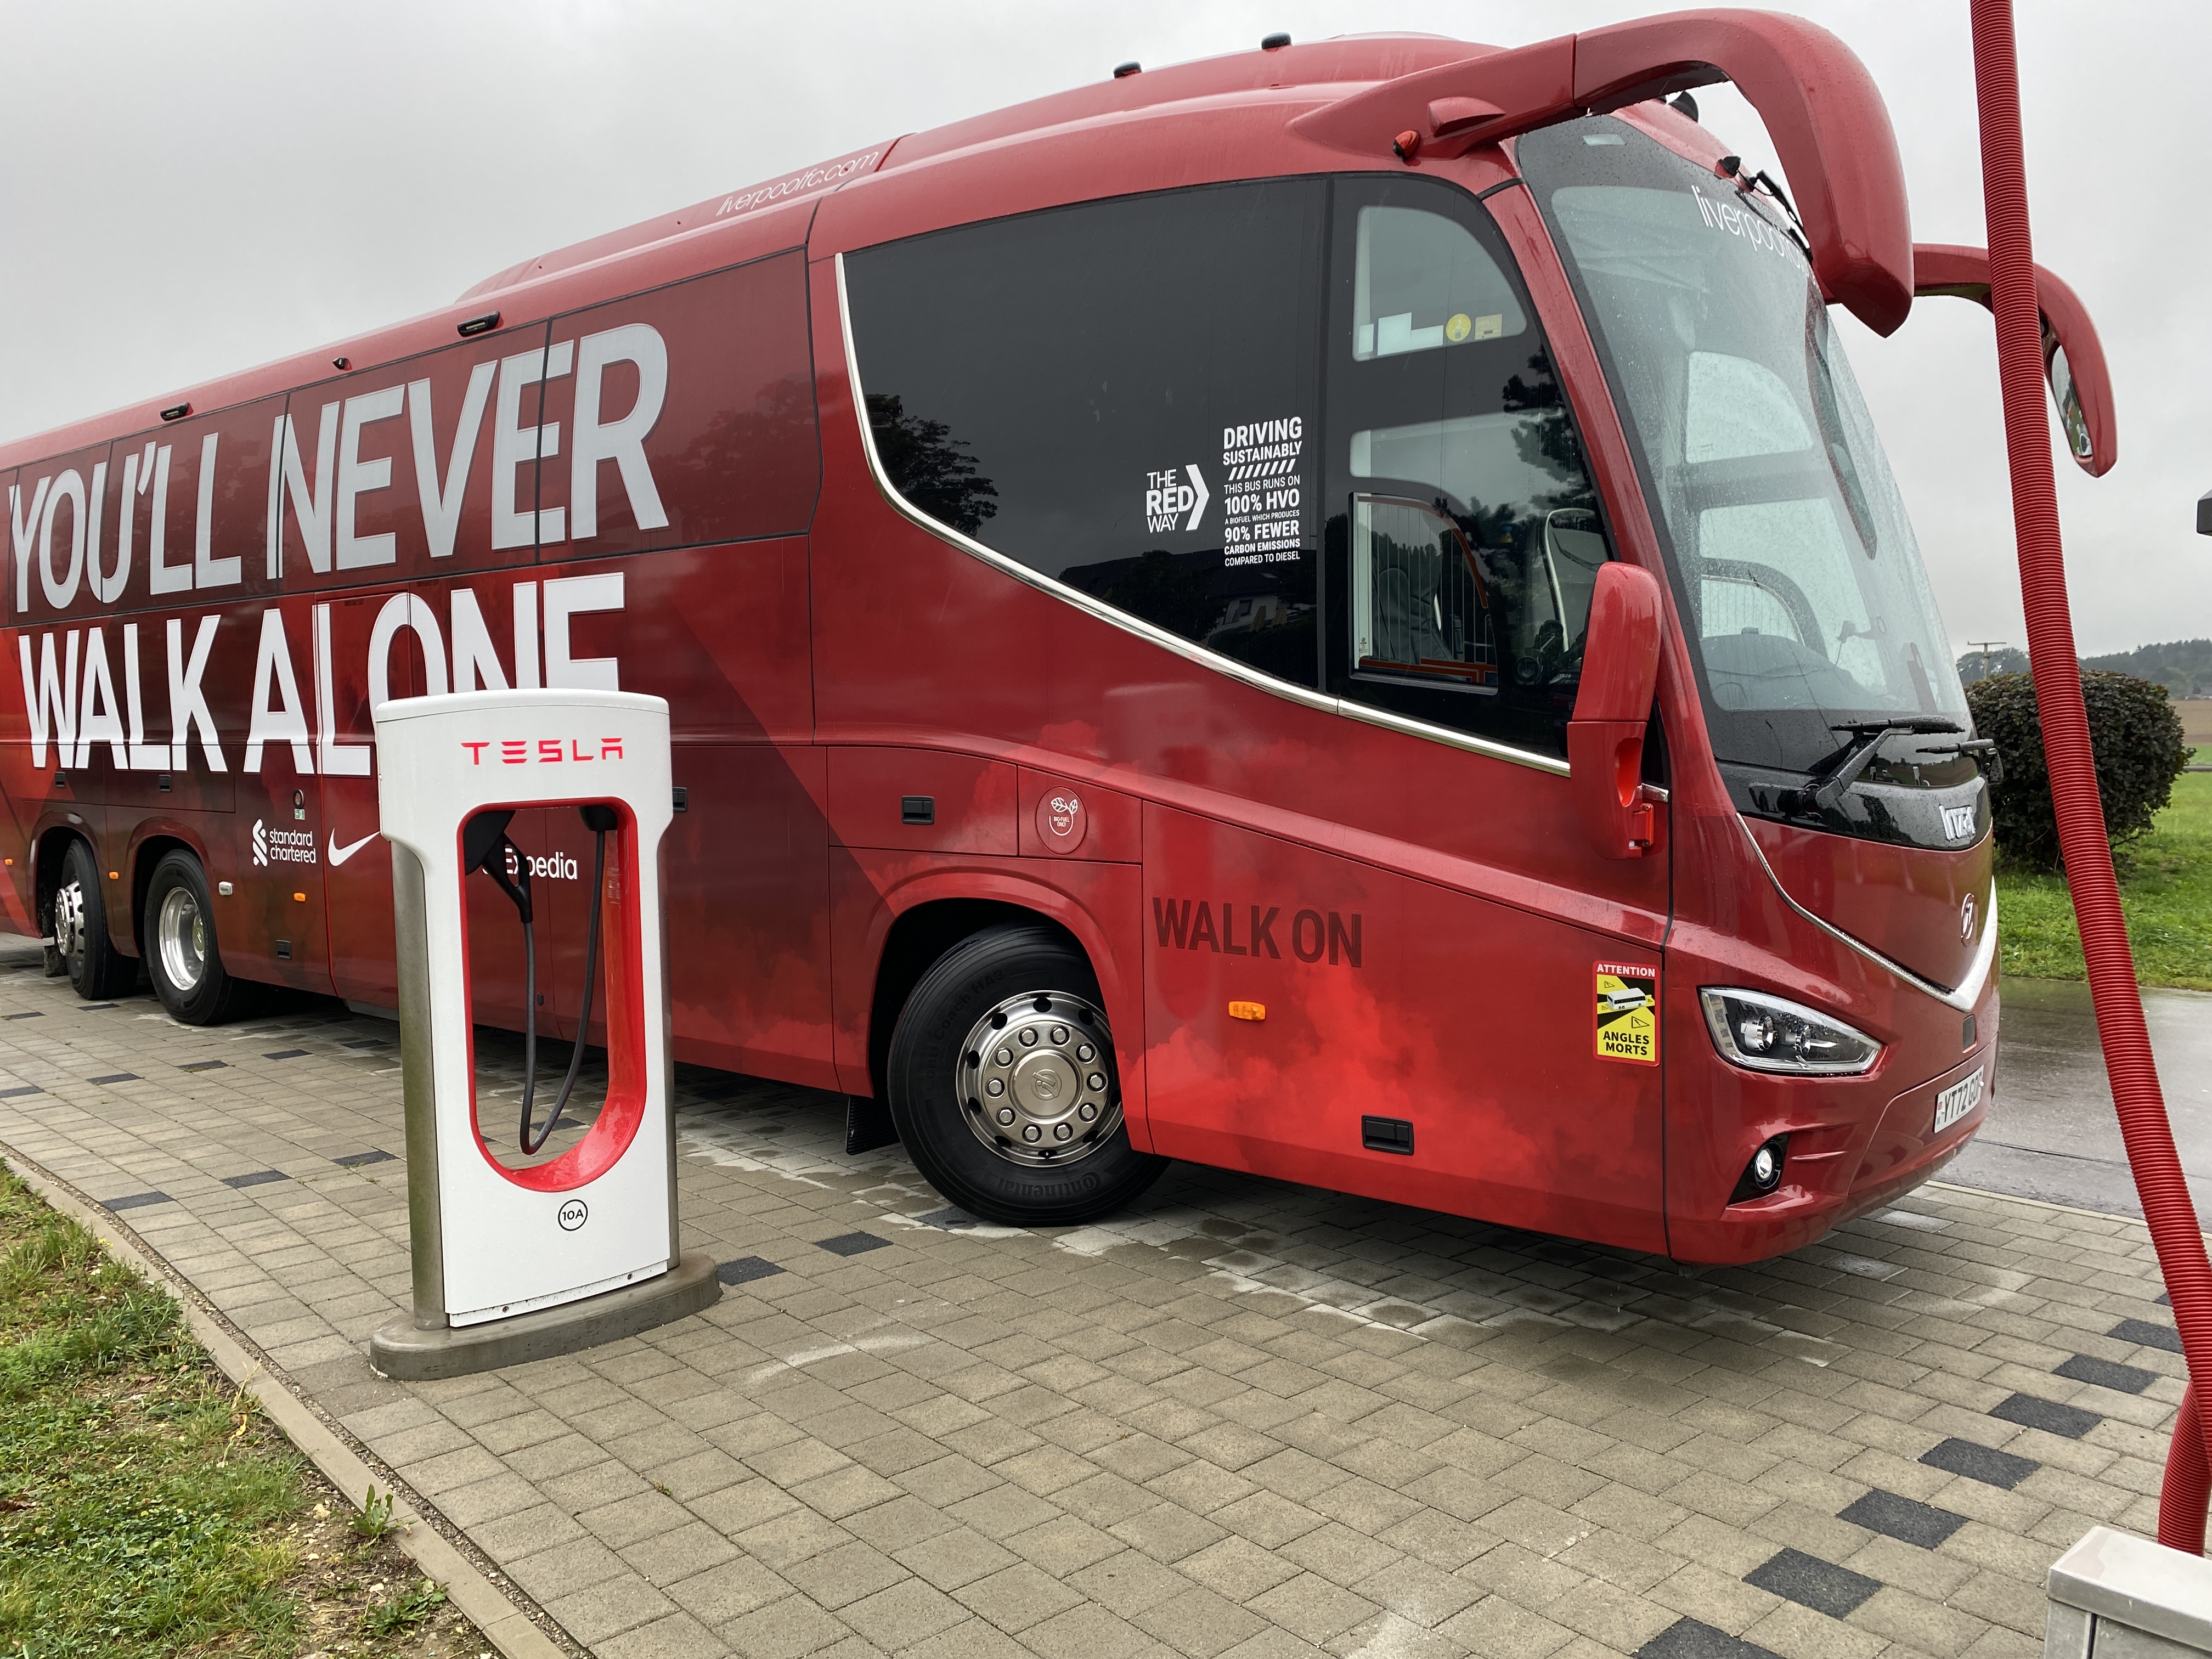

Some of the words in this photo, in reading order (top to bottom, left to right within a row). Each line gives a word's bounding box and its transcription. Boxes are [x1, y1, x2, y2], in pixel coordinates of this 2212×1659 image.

[716, 151, 879, 216] liverpoolfc.com
[1223, 416, 1302, 449] DRIVING
[1223, 441, 1302, 466] SUSTAINABLY
[8, 432, 242, 613] YOU'LL
[267, 323, 669, 580] NEVER
[1147, 469, 1177, 489] THE
[1223, 483, 1243, 495] THIS
[1244, 480, 1261, 492] BUS
[1263, 477, 1285, 489] RUNS
[1288, 475, 1300, 486] ON
[1146, 485, 1194, 516] RED
[1224, 493, 1262, 515] 100%
[1266, 488, 1300, 510] HVO
[1147, 513, 1179, 533] WAY
[1229, 515, 1251, 524] BIOFUEL
[1252, 514, 1270, 522] WHICH
[1271, 510, 1300, 520] PRODUCES
[1224, 525, 1250, 543] 90%
[1254, 520, 1300, 540] FEWER
[1224, 544, 1256, 555] CARBON
[1257, 538, 1301, 552] EMISSIONS
[1224, 555, 1263, 567] COMPARED
[1264, 554, 1274, 563] TO
[1276, 550, 1301, 561] DIESEL
[18, 614, 228, 772] WALK
[461, 737, 623, 765] TESLA
[269, 828, 313, 847] standard
[270, 847, 317, 864] chartered
[1153, 896, 1282, 960] WALK
[1291, 909, 1363, 968] ON
[1597, 964, 1655, 977] ATTENTION
[1603, 1031, 1650, 1045] ANGLES
[1606, 1042, 1647, 1056] MORTS
[1944, 1083, 1968, 1122] YT72
[996, 1171, 1102, 1199] Continental
[562, 1209, 584, 1221] 10A
